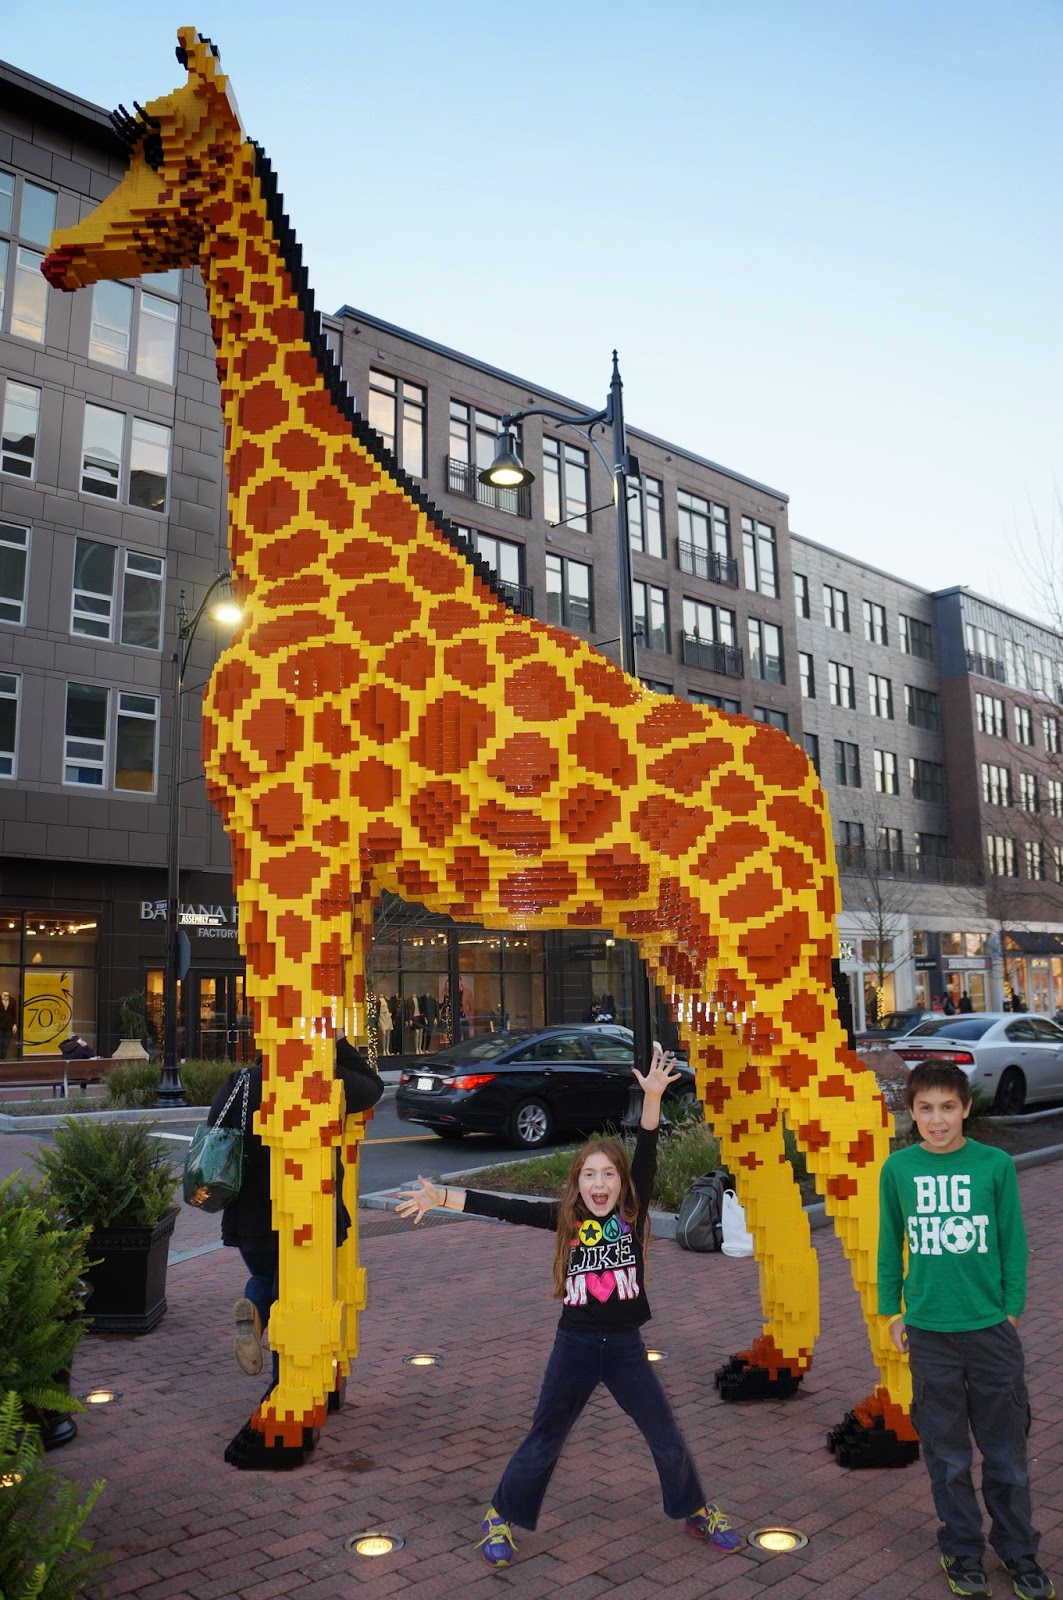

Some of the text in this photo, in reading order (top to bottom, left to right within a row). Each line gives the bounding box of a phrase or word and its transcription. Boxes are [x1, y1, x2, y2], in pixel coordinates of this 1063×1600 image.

[141, 902, 228, 922] BAANA
[181, 915, 209, 923] ASSEMBLY
[198, 928, 238, 938] FACTORY
[913, 1175, 971, 1213] BIG
[567, 1234, 636, 1274] LIKE
